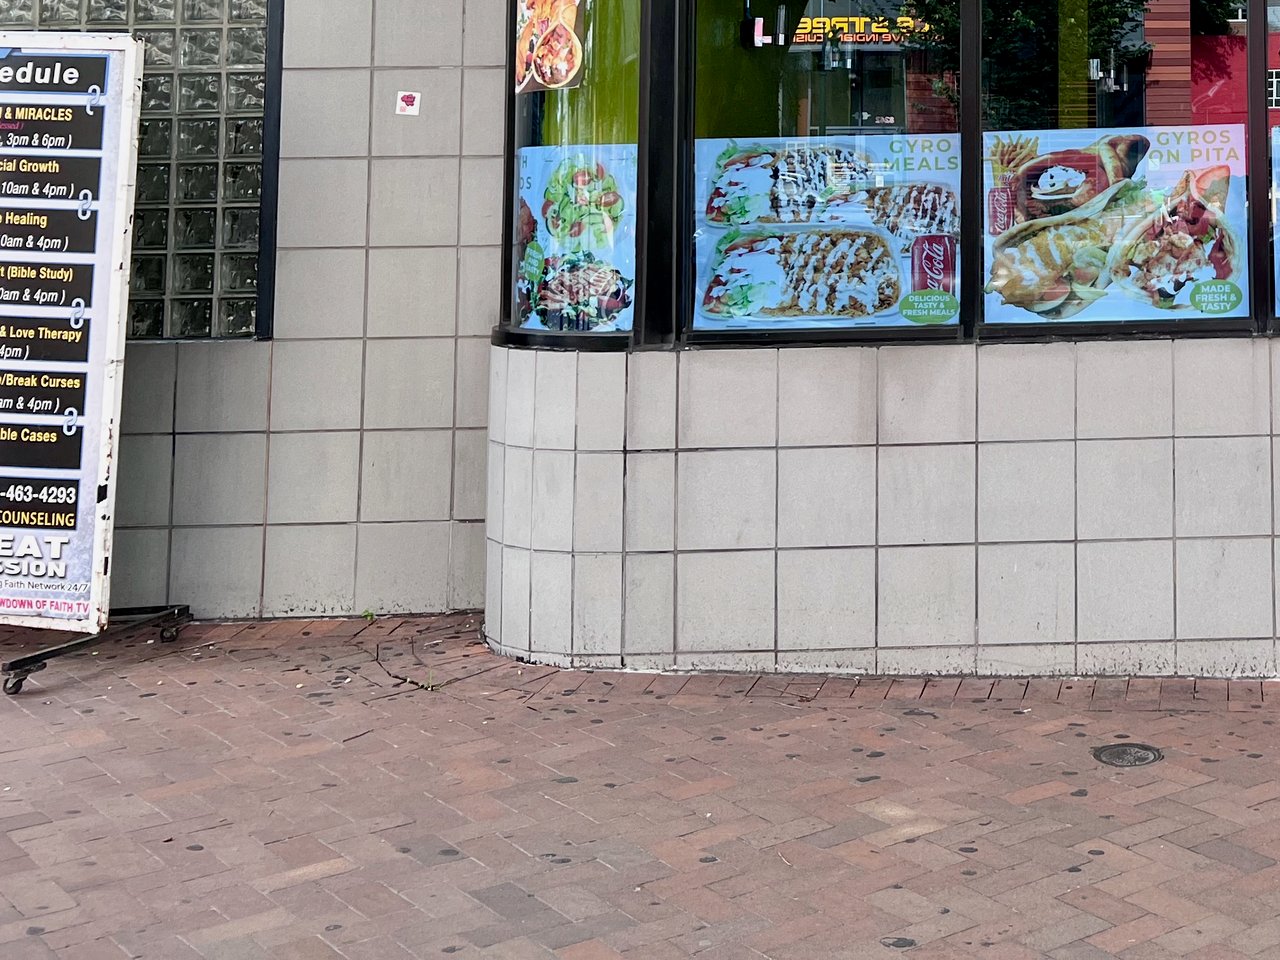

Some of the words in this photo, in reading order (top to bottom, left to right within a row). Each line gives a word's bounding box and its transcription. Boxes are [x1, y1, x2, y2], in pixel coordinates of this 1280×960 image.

[5, 107, 12, 119] &
[15, 107, 73, 121] MIRACLES
[7, 132, 29, 148] 3pm
[31, 133, 39, 146] &
[42, 133, 66, 149] 6pm
[889, 139, 952, 154] GYRO
[1156, 130, 1232, 147] GYROS
[1148, 148, 1181, 163] ON
[1191, 147, 1240, 162] PITA
[19, 159, 60, 173] Growth
[883, 156, 959, 172] MEALS
[1, 181, 29, 195] 10am
[31, 182, 40, 195] &
[42, 182, 67, 199] 4pm
[5, 211, 48, 228] Healing
[26, 234, 34, 248] &
[37, 235, 61, 251] 4pm
[7, 266, 37, 280] (Bible
[39, 266, 74, 282] Study)
[22, 288, 31, 301] &
[33, 288, 59, 304] 4pm
[1201, 284, 1231, 293] MADE
[1195, 293, 1228, 302] FRESH
[1230, 293, 1237, 302] &
[929, 308, 956, 316] MEALS
[1199, 302, 1232, 311] TASTY
[0, 325, 7, 337] &
[9, 326, 35, 339] Love
[38, 327, 82, 342] Therapy
[0, 344, 22, 359] 4pm
[0, 373, 38, 387] /Break
[40, 375, 81, 389] Curses
[16, 396, 24, 410] &
[27, 397, 53, 413] 4pm
[21, 428, 57, 442] Cases
[0, 484, 76, 504] -463-4293
[0, 534, 69, 560] EAT
[0, 560, 67, 578] SION
[4, 580, 26, 589] Faith
[27, 581, 65, 591] Network
[67, 583, 89, 592] 24/7
[36, 600, 47, 610] OF
[49, 600, 73, 613] FAITH
[76, 602, 89, 613] TV
